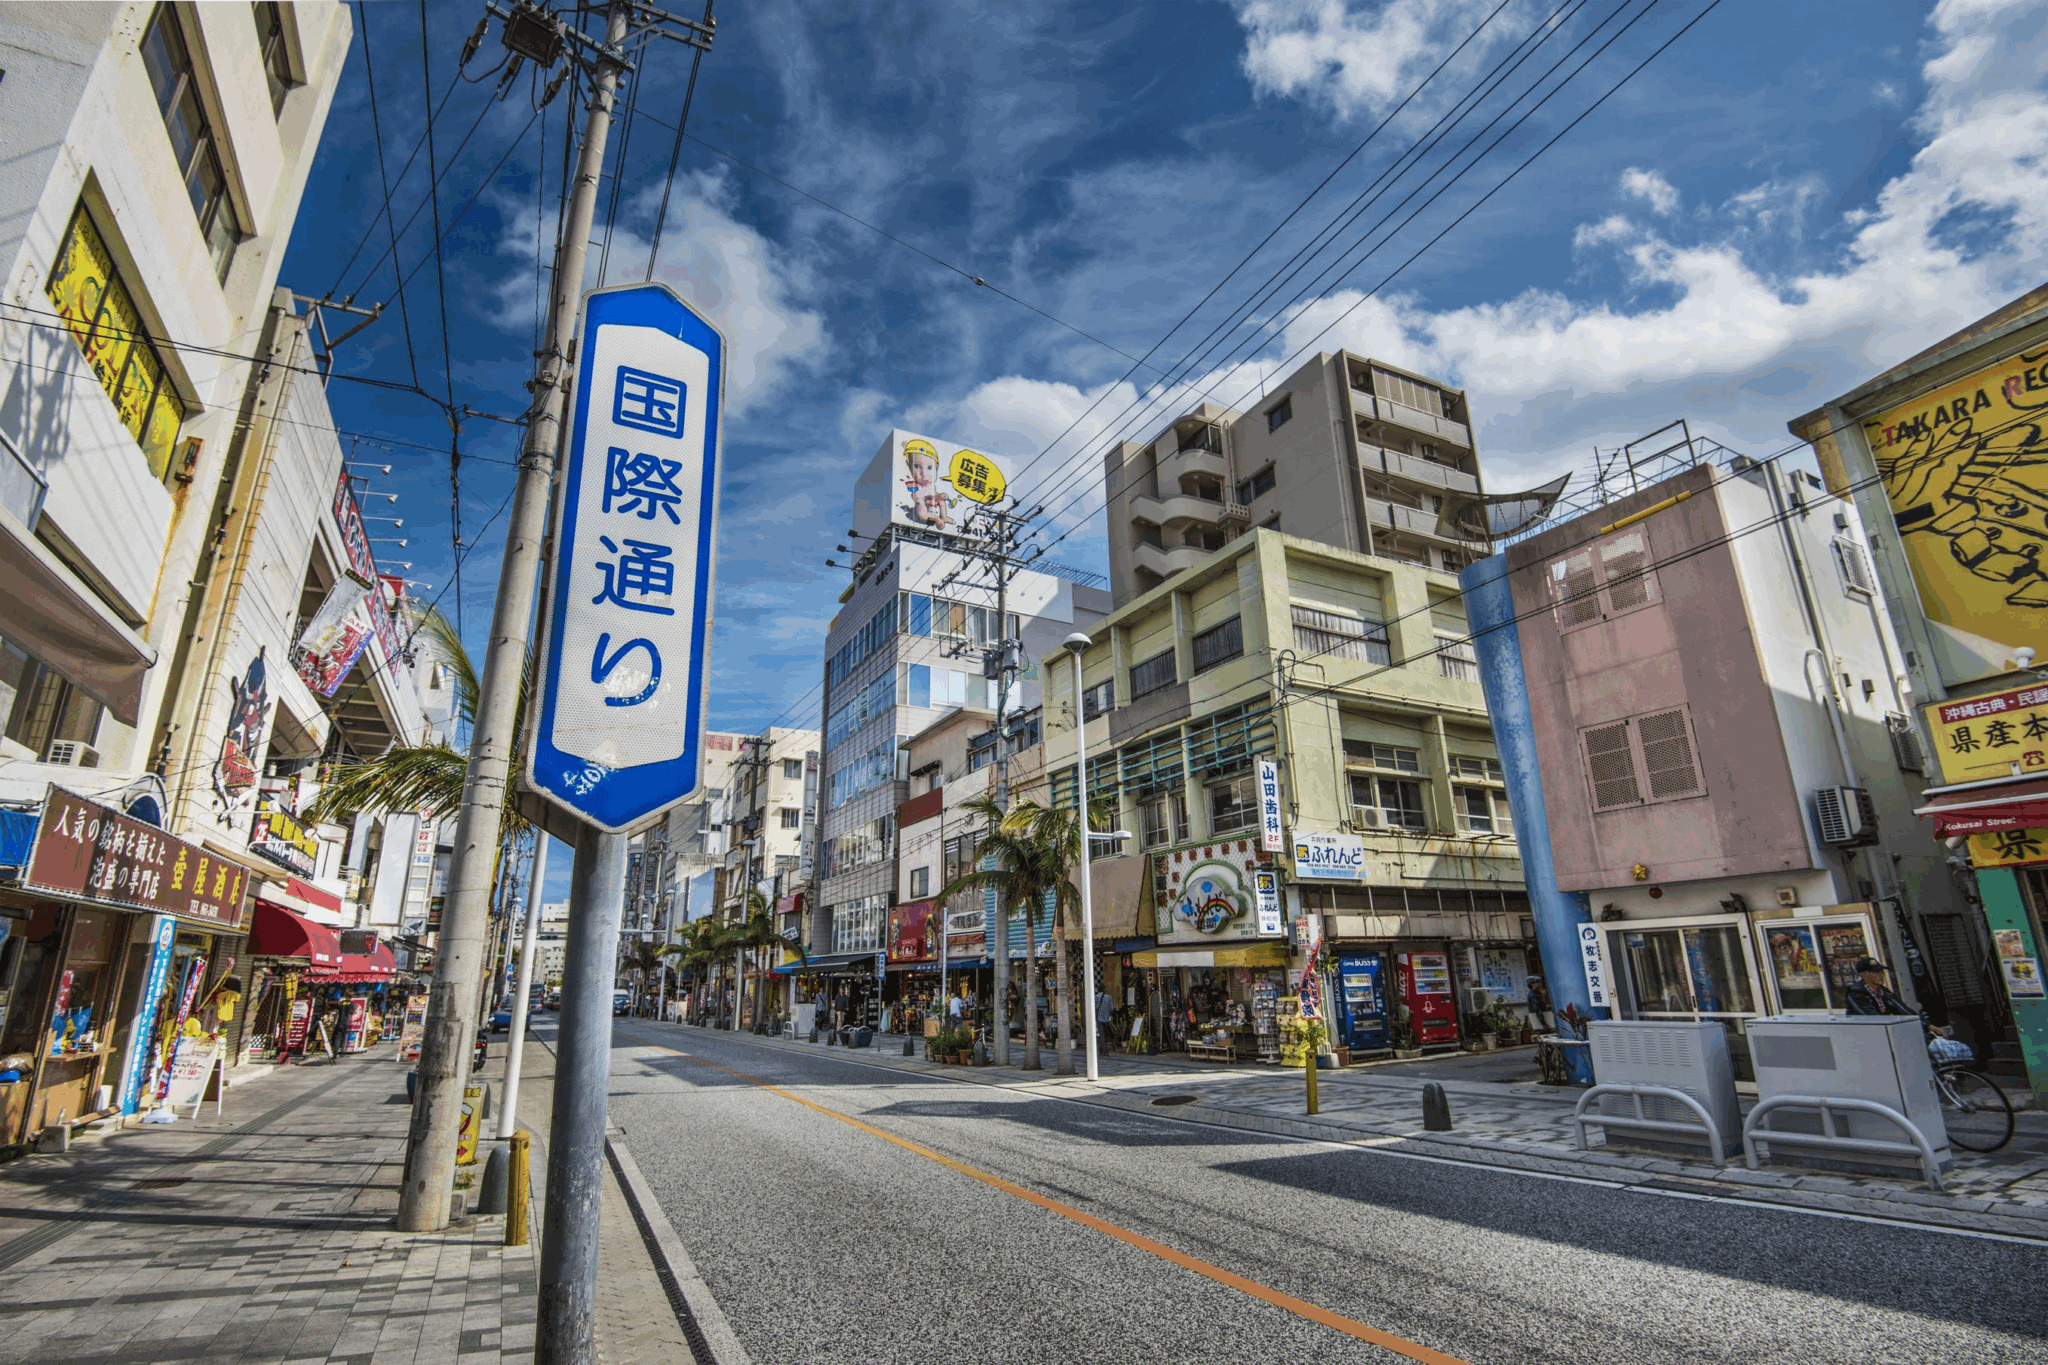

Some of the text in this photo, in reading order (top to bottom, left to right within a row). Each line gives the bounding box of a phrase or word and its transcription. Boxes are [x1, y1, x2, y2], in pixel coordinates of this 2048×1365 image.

[1881, 388, 1992, 447] TAKARA
[960, 457, 990, 481] 広告
[957, 471, 987, 495] 募集
[591, 364, 688, 708] 国際通り
[1950, 712, 2048, 754] 県産本
[1262, 764, 1279, 833] 山田歯科
[53, 804, 166, 866] 人気の銘柄を揃えた
[1268, 834, 1279, 842] 2F
[1944, 819, 1983, 831] Kokusai
[1312, 845, 1362, 865] ふれんど
[1992, 829, 2042, 860] 県
[89, 855, 161, 900] 泡盛の専門店
[171, 846, 243, 905] 壺屋酒店
[189, 899, 200, 914] TEL
[1259, 903, 1278, 912] ふれんど
[1354, 958, 1371, 967] BOSS
[1585, 944, 1603, 1004] 牧志交番
[1333, 978, 1342, 1002] BOSS
